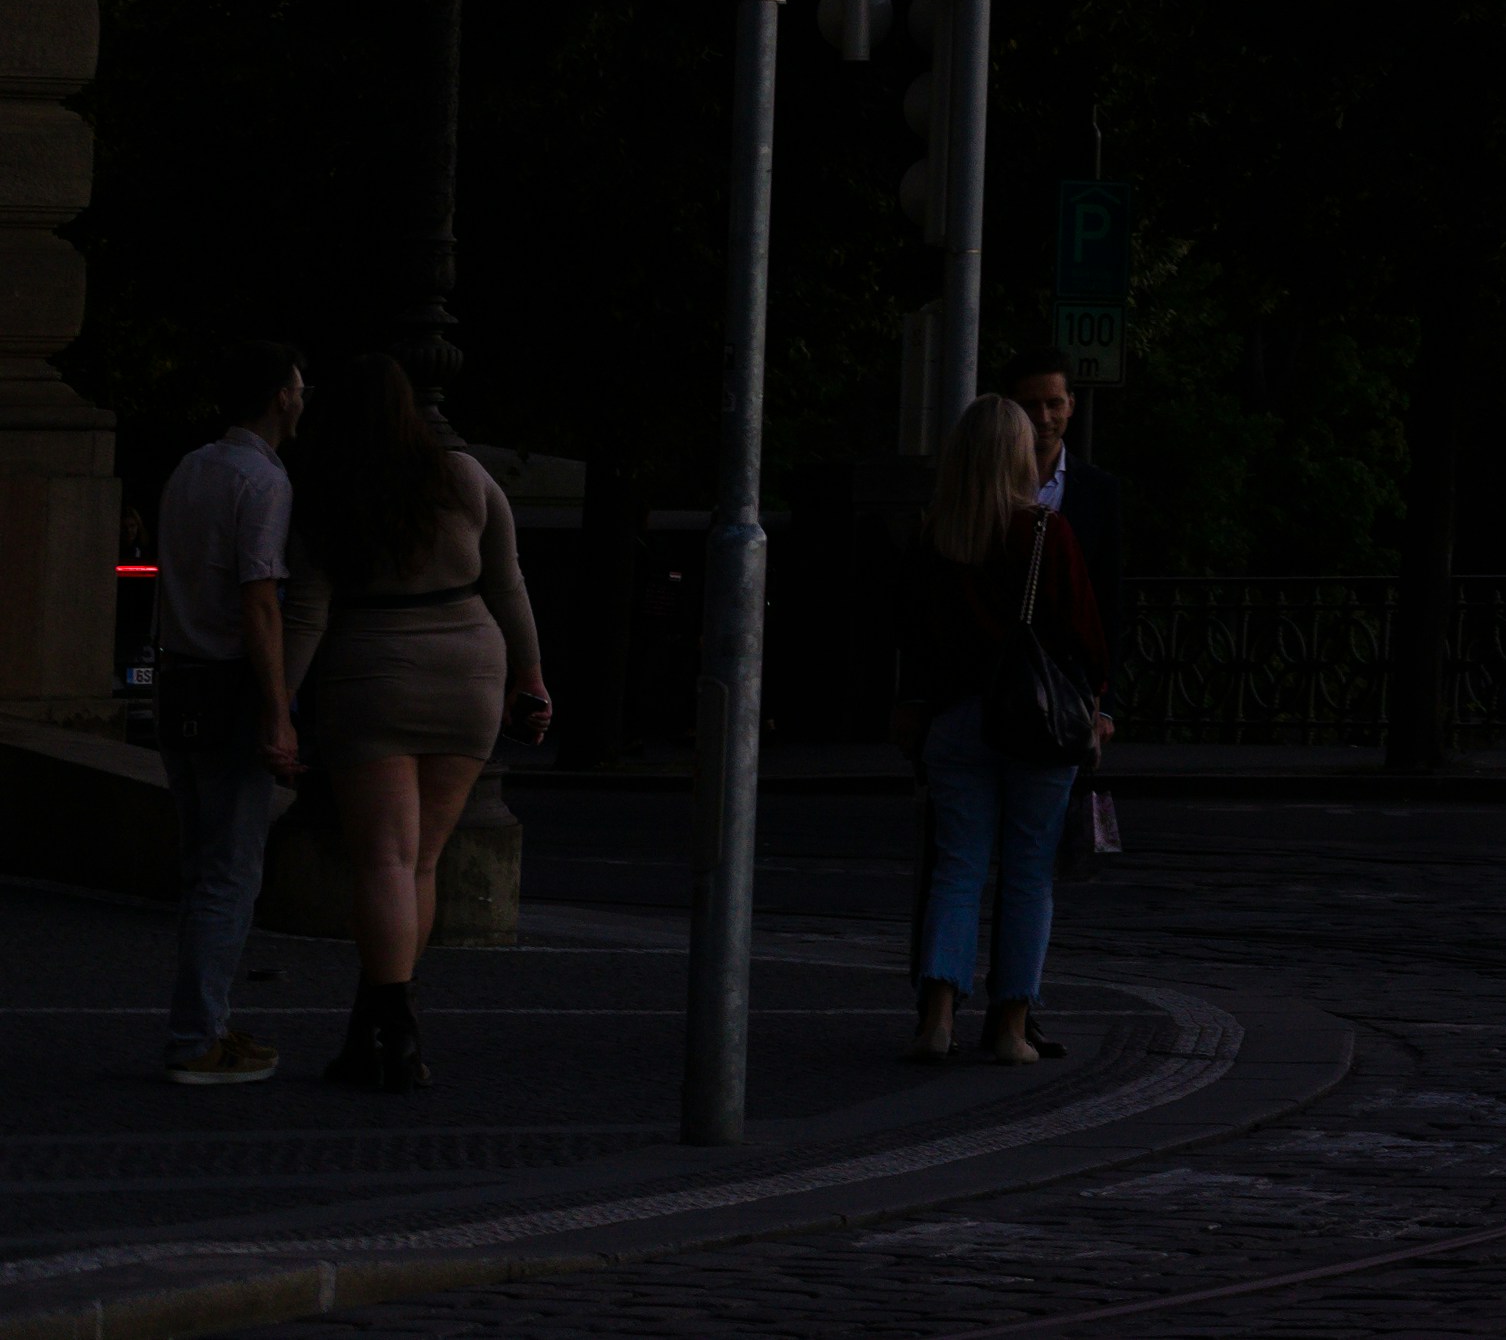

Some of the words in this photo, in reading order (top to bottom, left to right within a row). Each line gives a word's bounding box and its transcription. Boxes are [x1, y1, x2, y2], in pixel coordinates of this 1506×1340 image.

[1074, 204, 1112, 263] P
[1064, 311, 1114, 347] 100
[1078, 357, 1099, 377] m
